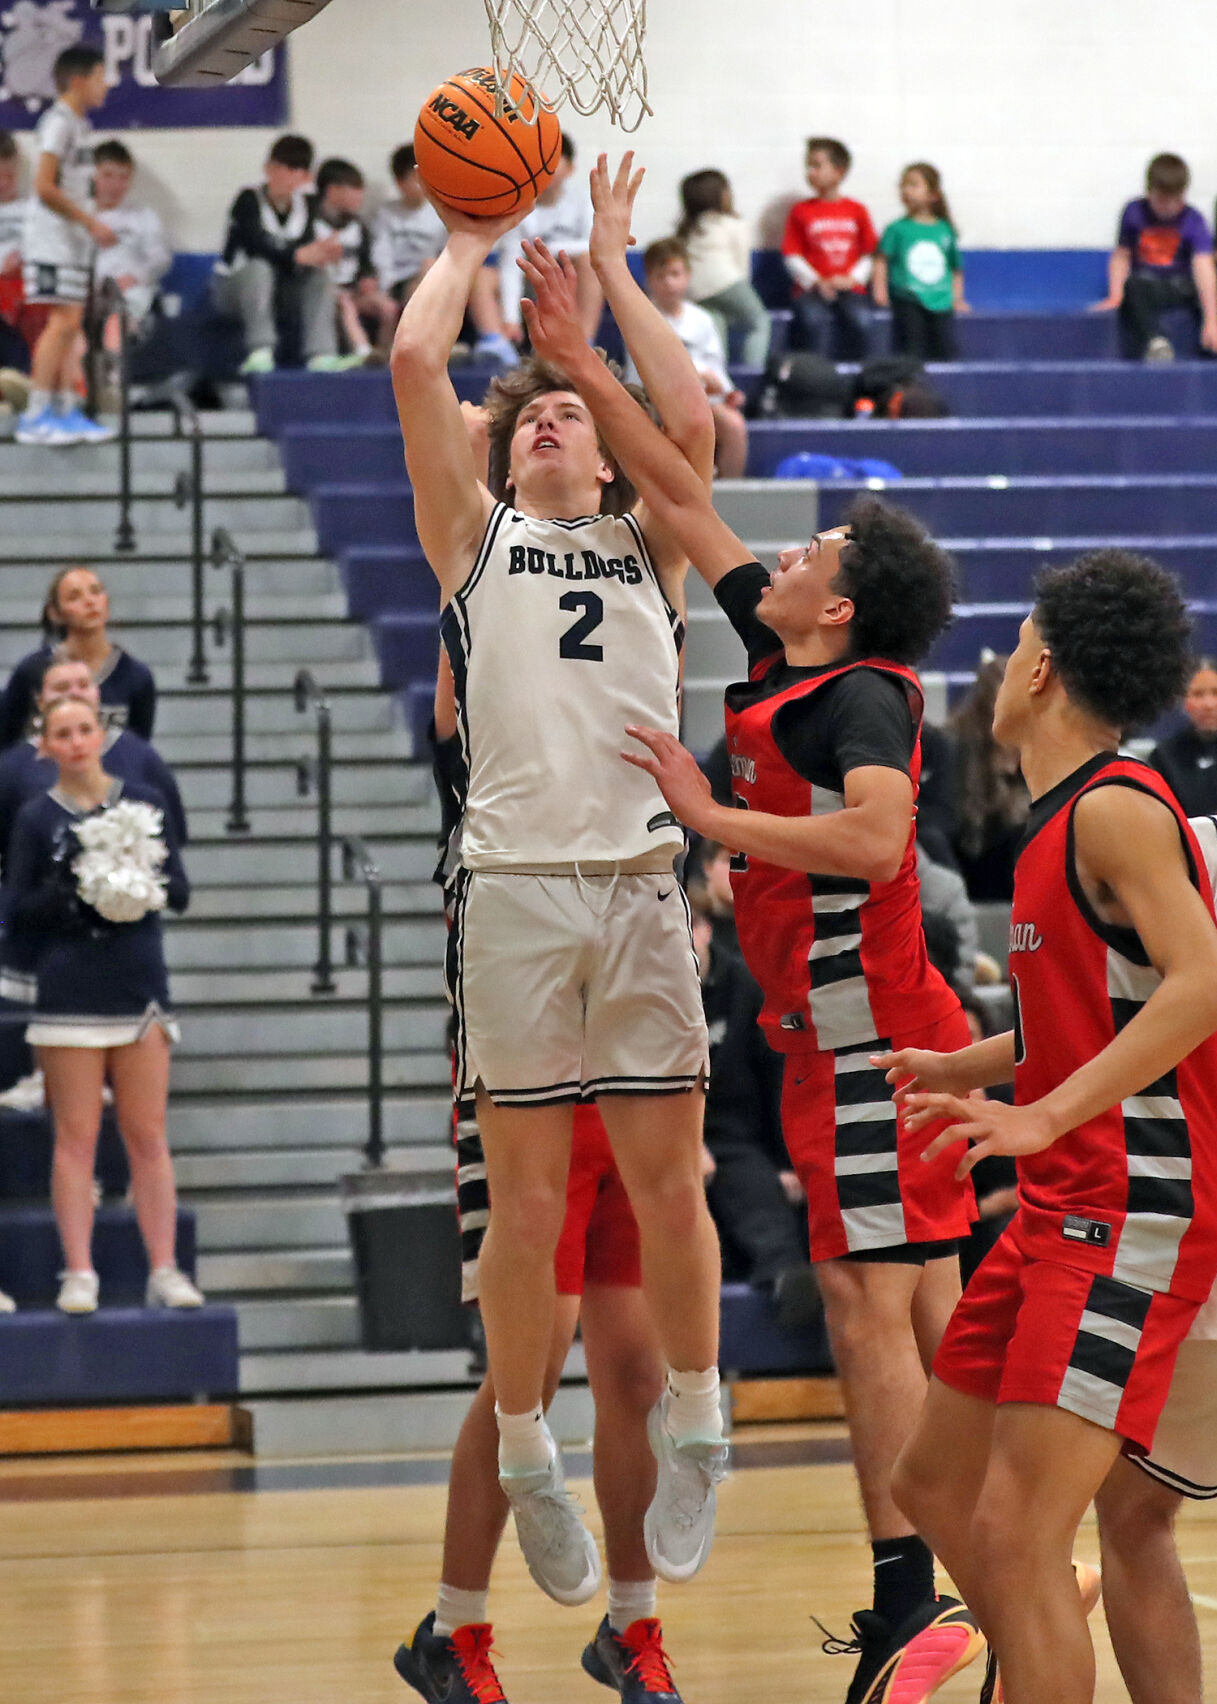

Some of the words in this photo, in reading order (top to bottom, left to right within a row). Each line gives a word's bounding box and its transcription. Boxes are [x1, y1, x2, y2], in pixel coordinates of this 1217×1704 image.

[428, 93, 480, 141] NCAA
[559, 590, 604, 662] 2
[1094, 1227, 1101, 1239] L
